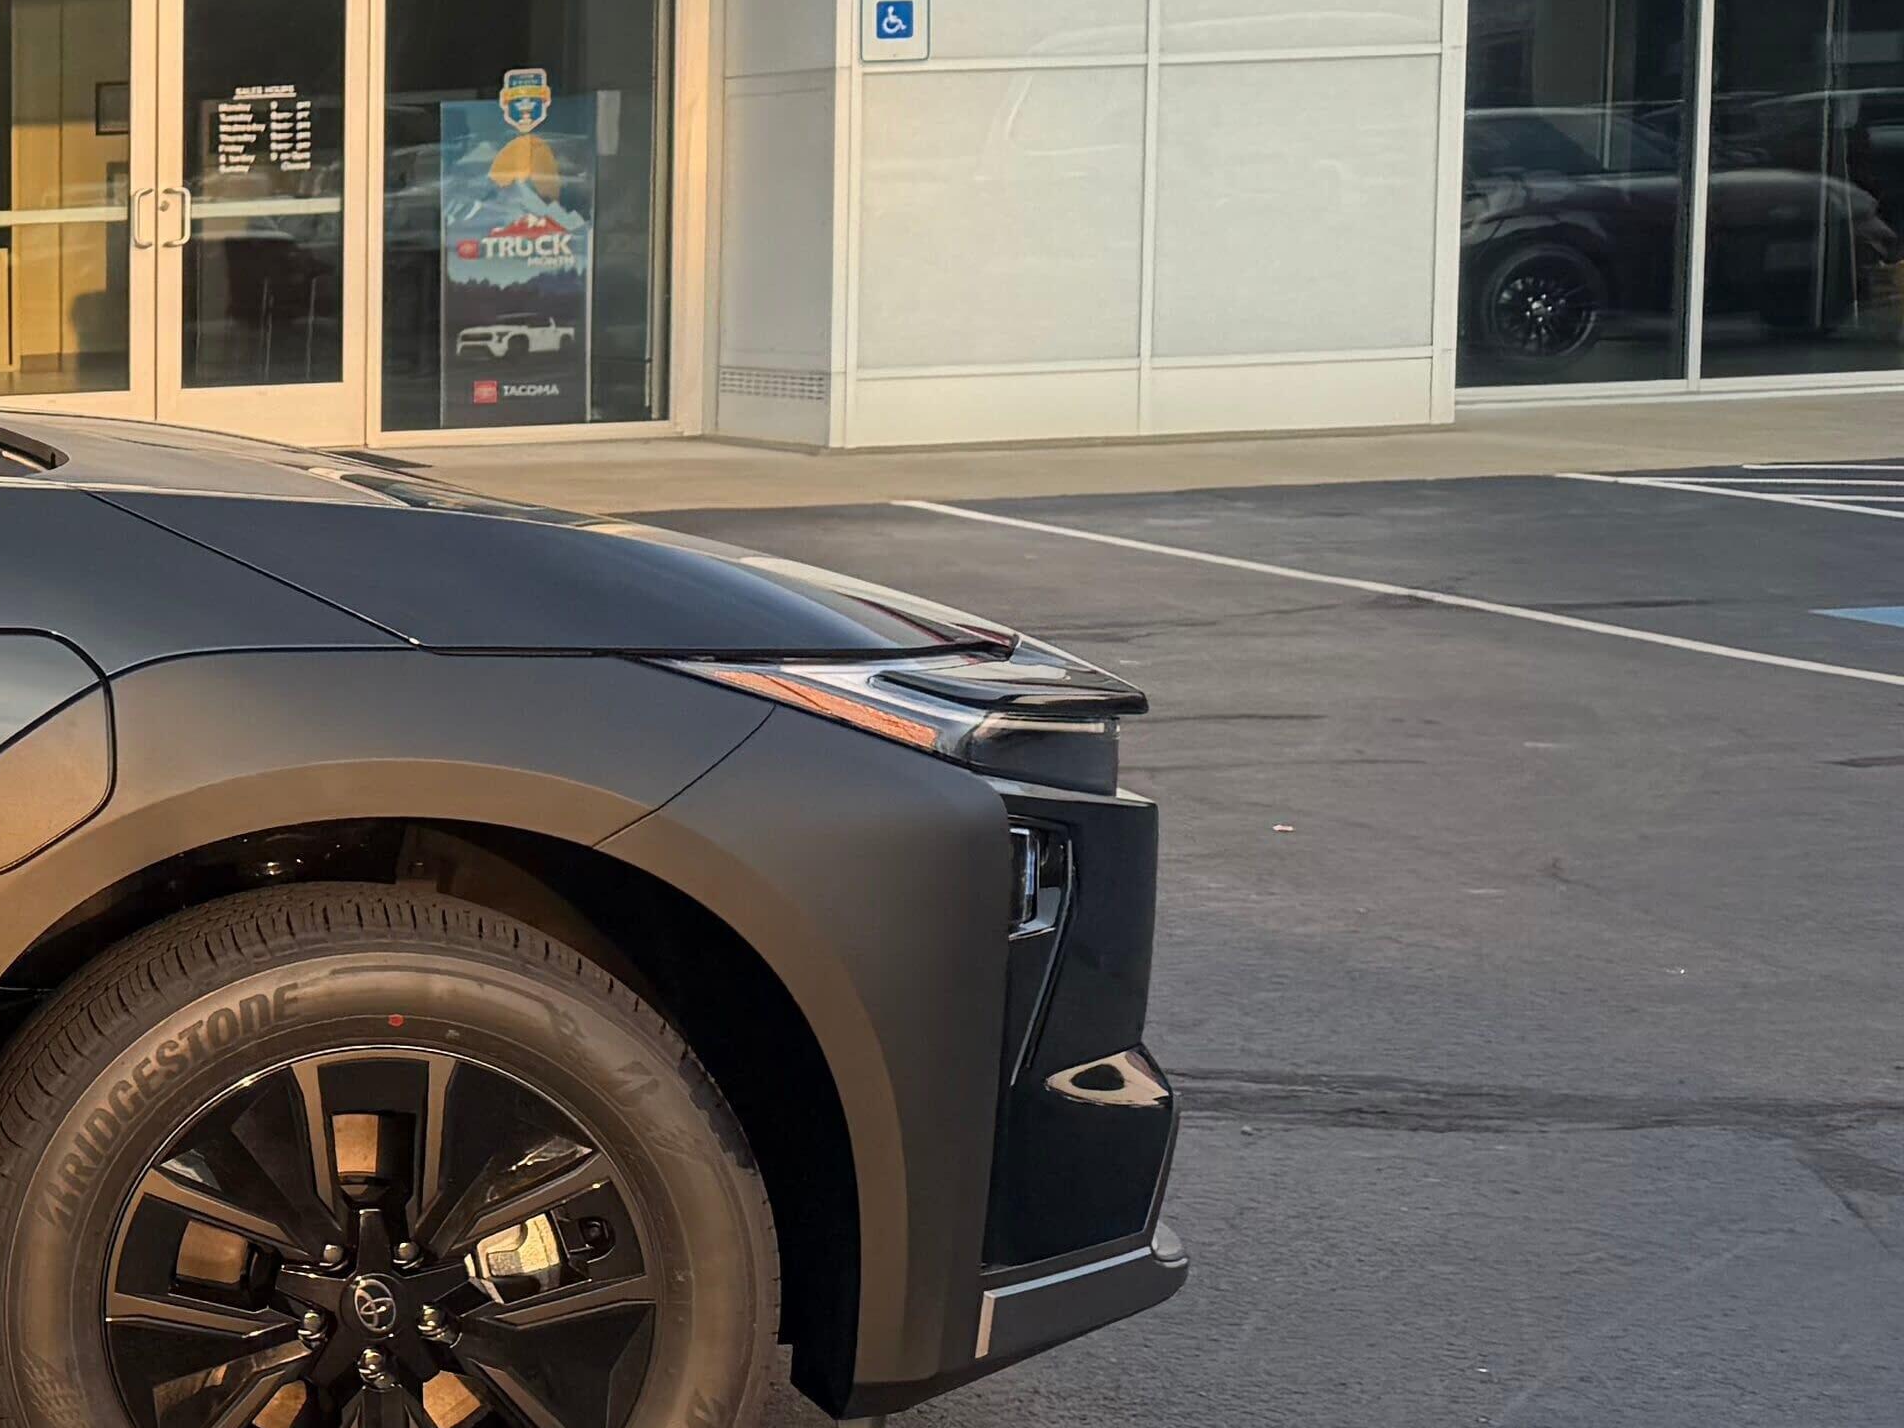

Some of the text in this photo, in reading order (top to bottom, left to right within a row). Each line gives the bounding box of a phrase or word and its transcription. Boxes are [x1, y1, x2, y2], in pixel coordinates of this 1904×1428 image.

[482, 234, 573, 259] TRUCK
[503, 384, 560, 397] TACOMA
[40, 980, 304, 1230] BRIDGESTONE
